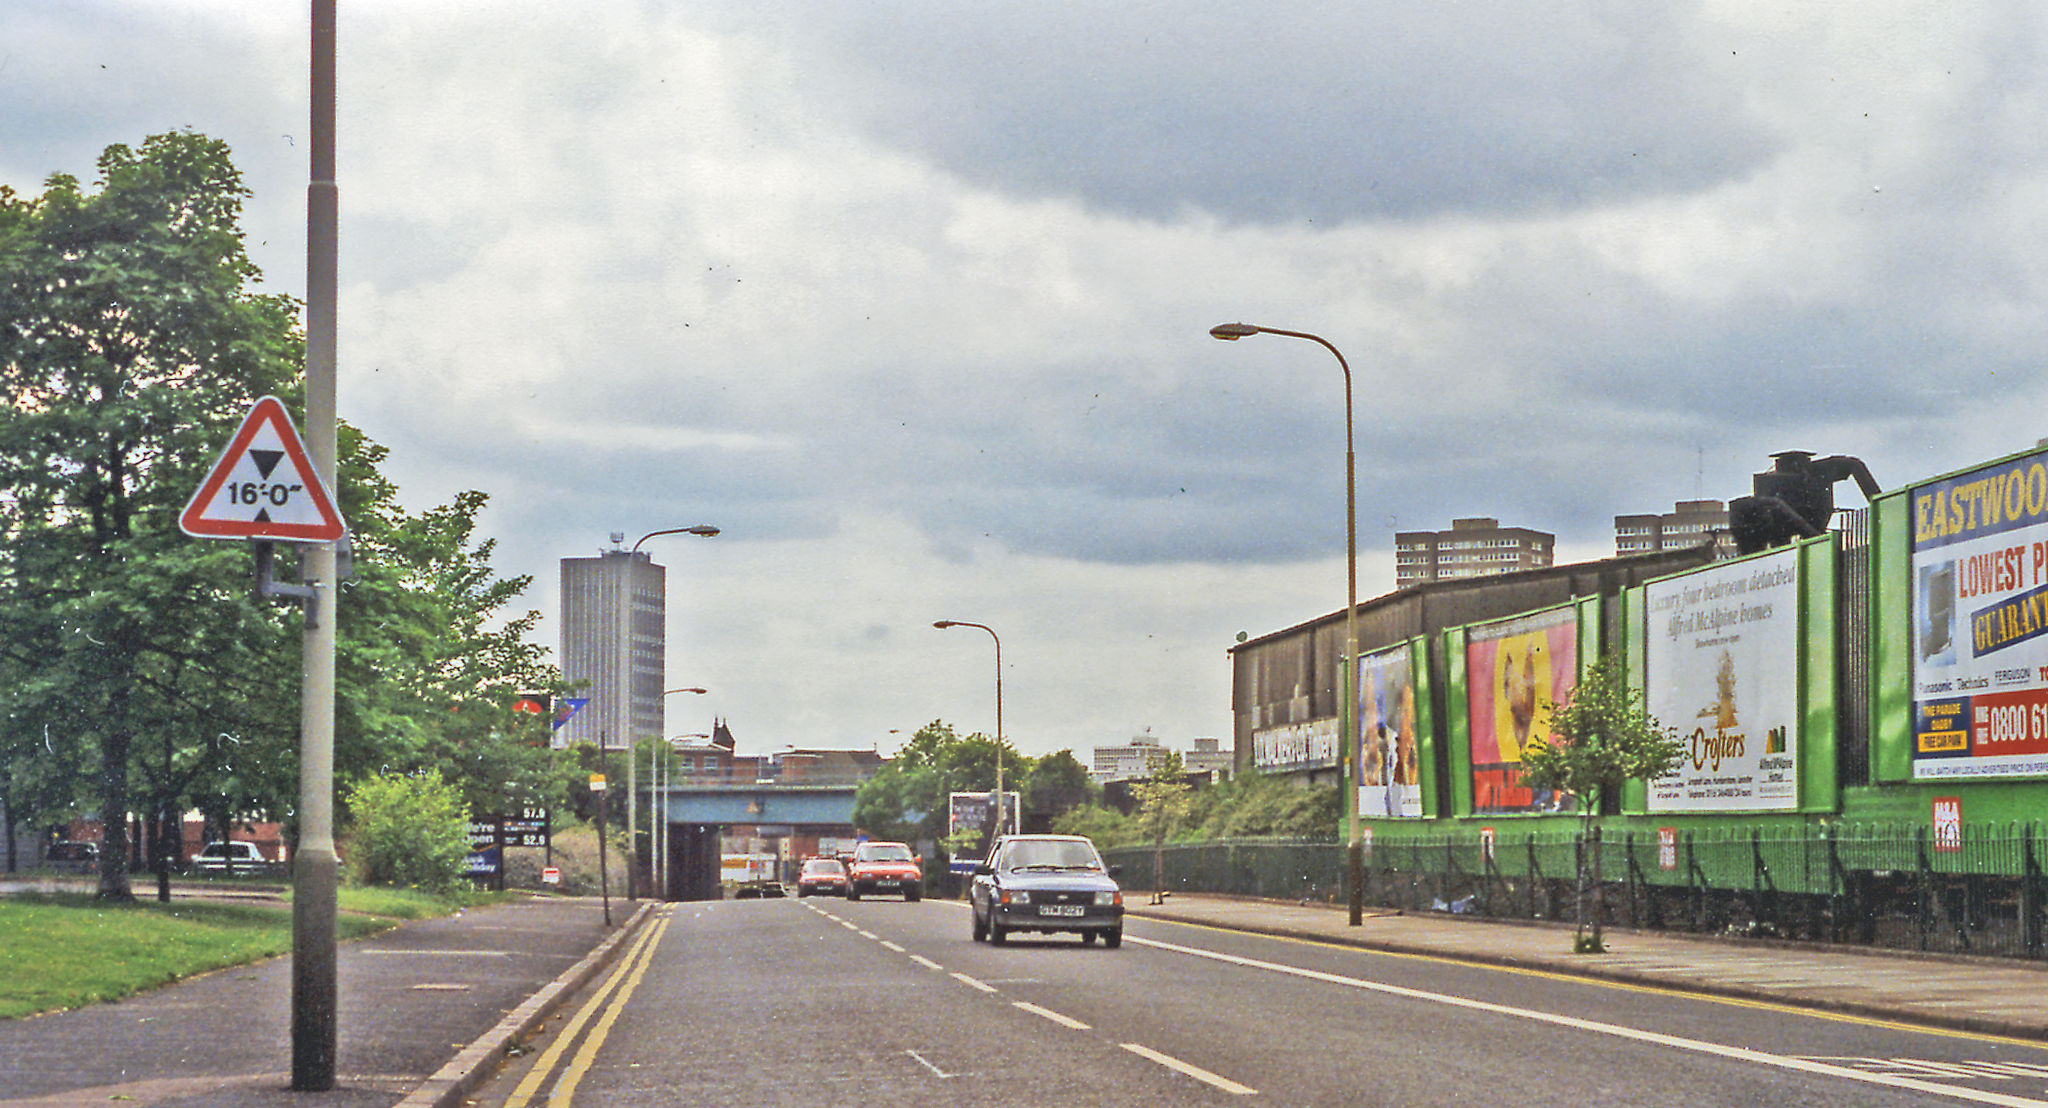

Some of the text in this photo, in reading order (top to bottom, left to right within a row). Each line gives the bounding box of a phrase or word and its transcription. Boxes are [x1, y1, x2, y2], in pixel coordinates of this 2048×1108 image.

[1916, 463, 2048, 543] EASTWOO
[1749, 560, 1795, 591] detached
[1959, 546, 2026, 598] LOWEST
[1695, 607, 1738, 634] McAlpine
[1740, 602, 1773, 623] homes
[1957, 677, 1989, 690] Technics
[1995, 668, 2030, 680] FERGUSON
[1991, 704, 2027, 742] 0800
[1693, 727, 1745, 771] Crofters
